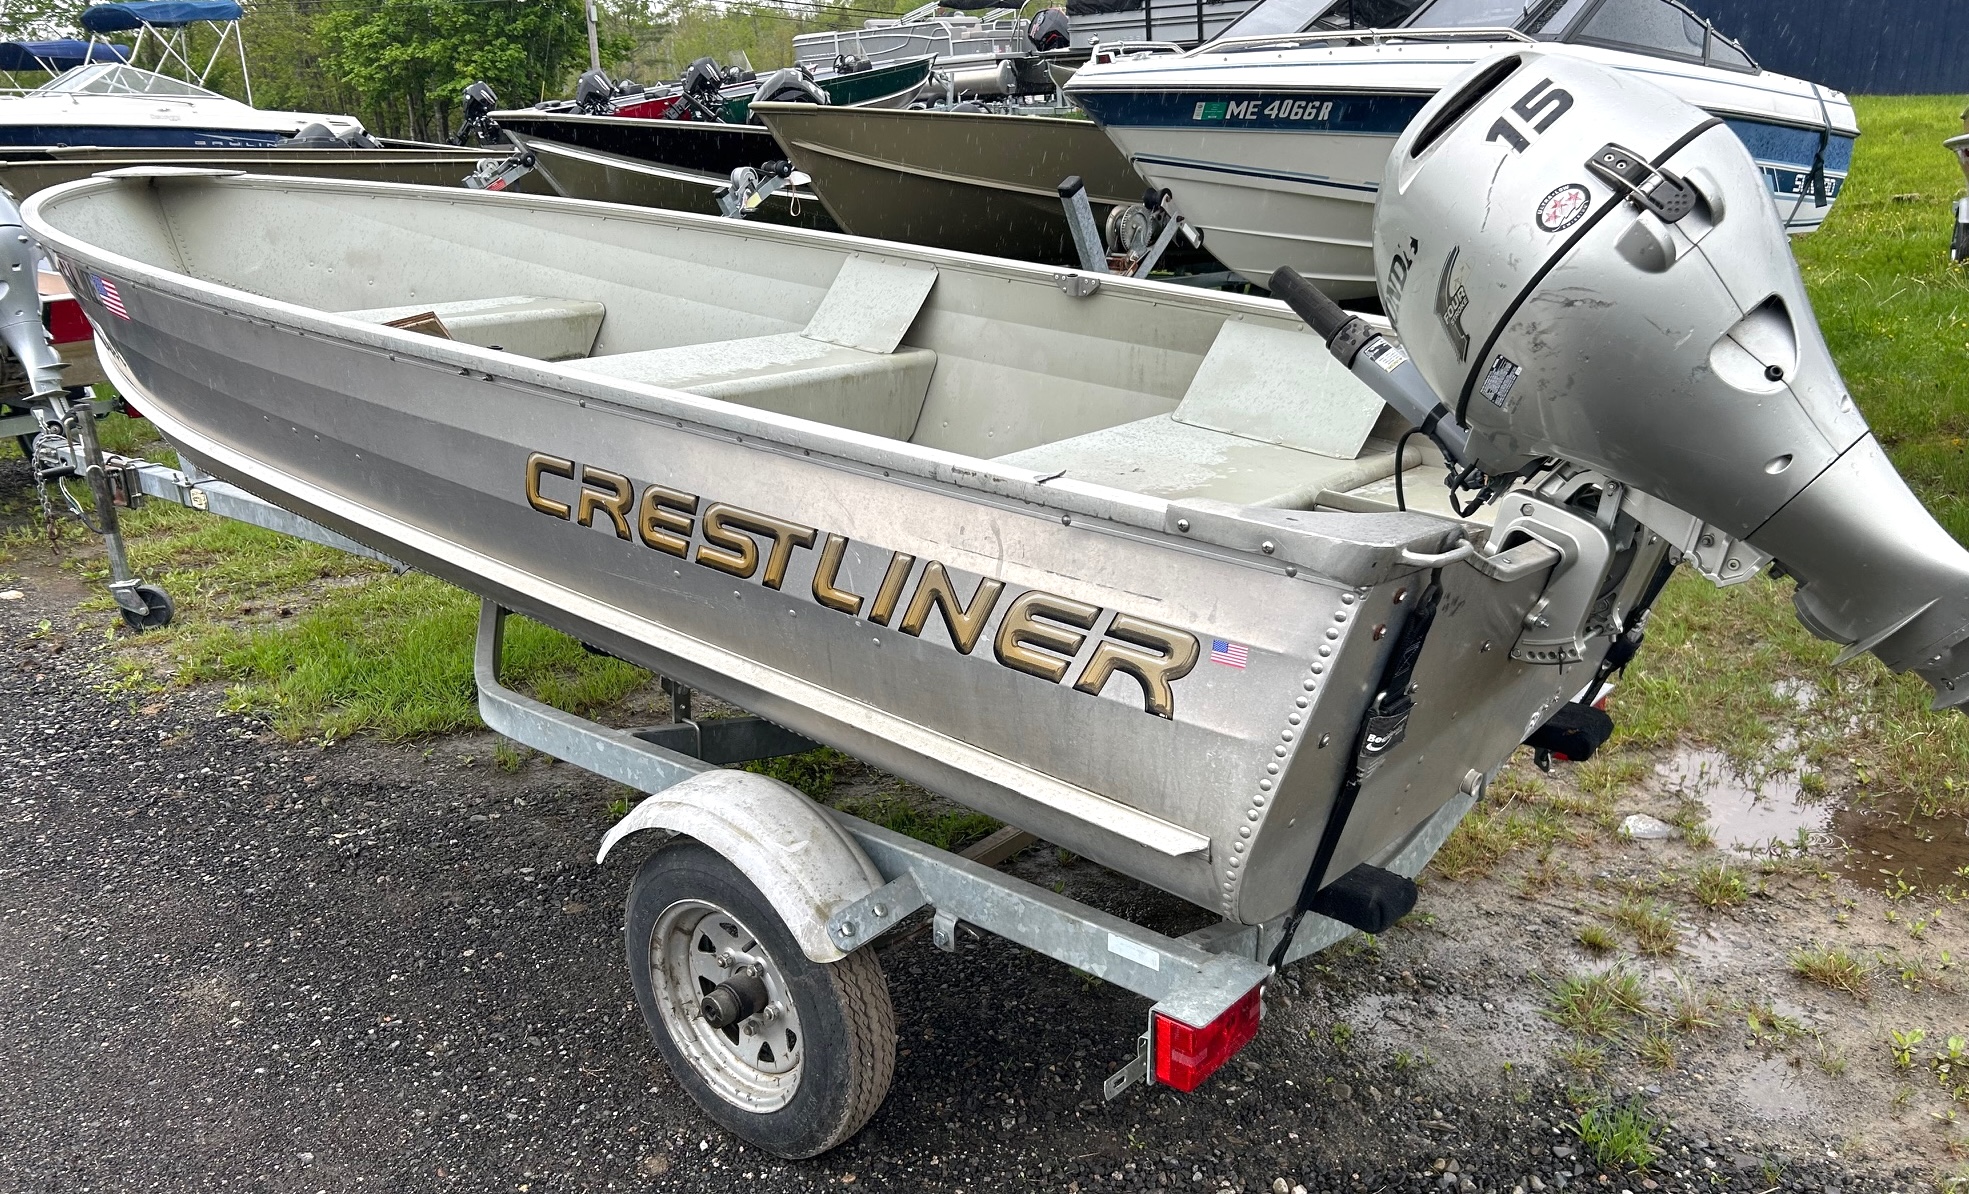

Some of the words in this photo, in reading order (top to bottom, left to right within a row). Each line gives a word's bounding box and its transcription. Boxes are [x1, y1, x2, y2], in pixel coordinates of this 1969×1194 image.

[1225, 100, 1262, 120] ME
[1485, 77, 1574, 154] 15
[1443, 285, 1466, 325] FOUR
[1450, 298, 1468, 326] STROKE
[525, 451, 1201, 721] CRESTLINER
